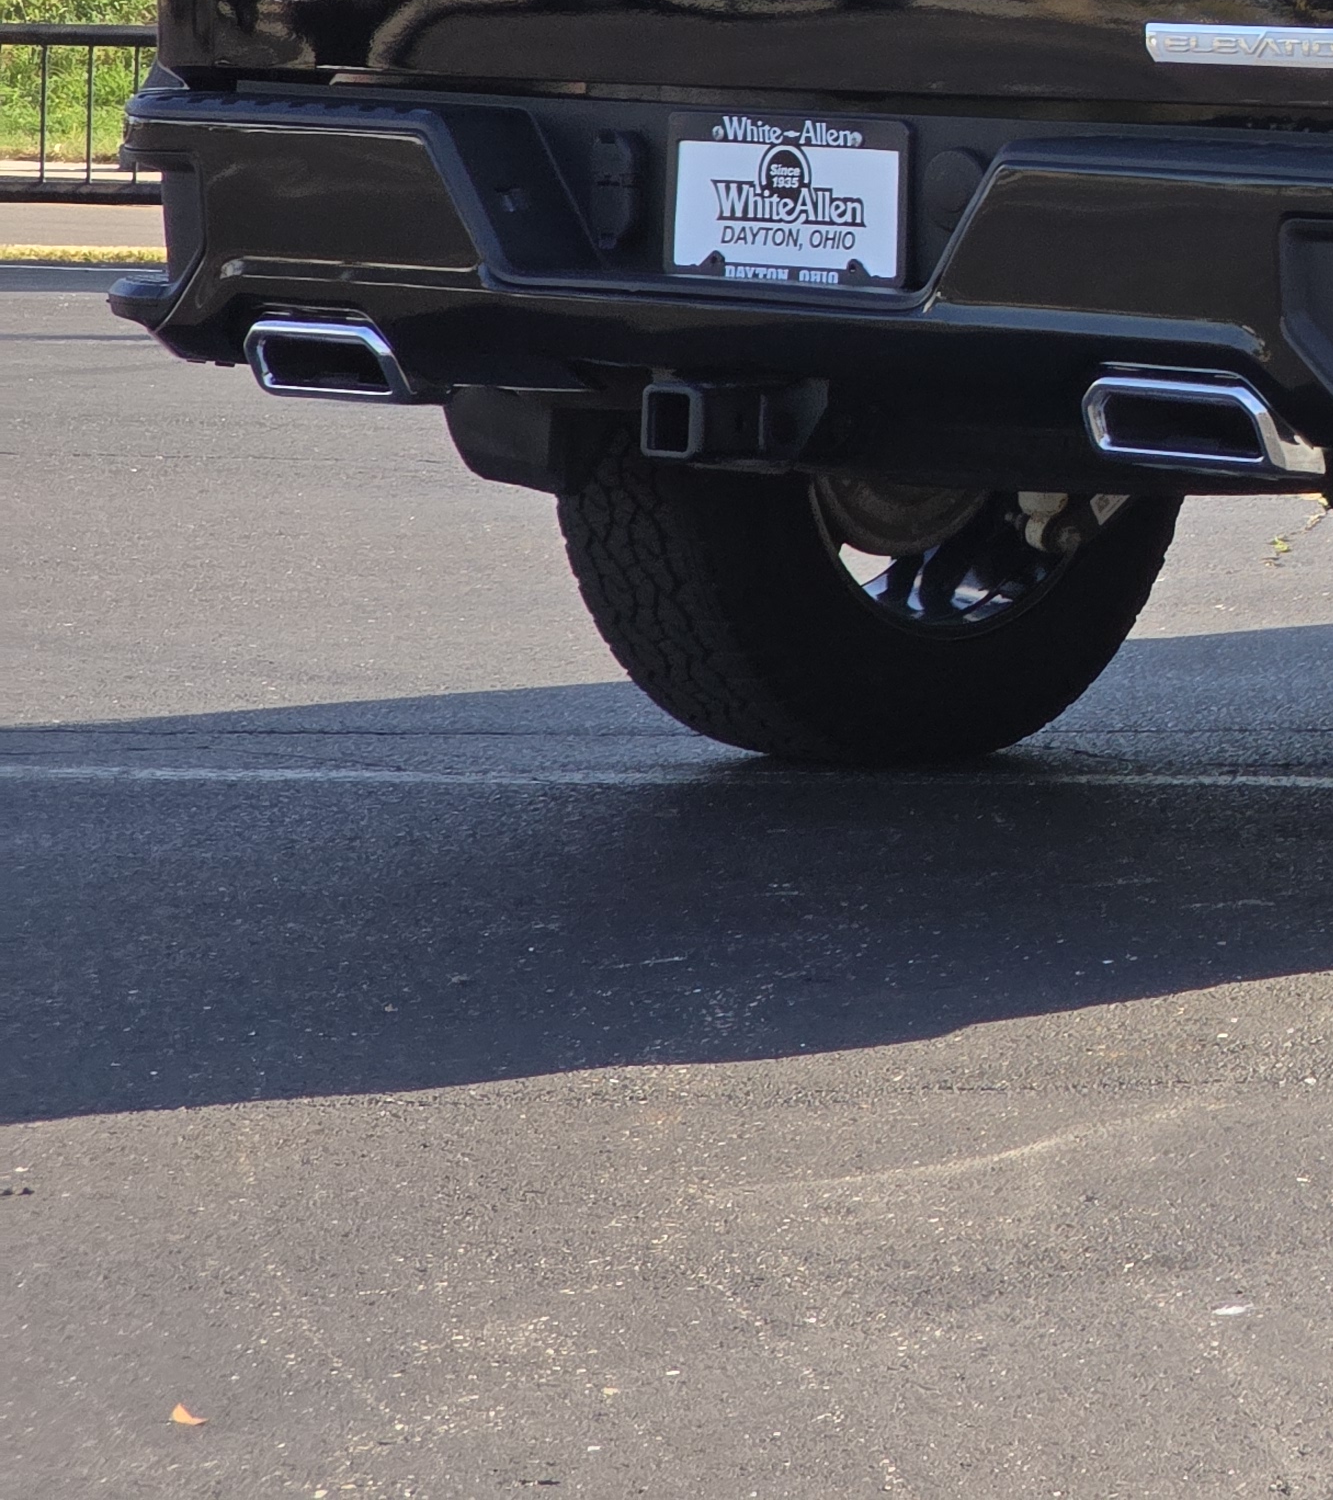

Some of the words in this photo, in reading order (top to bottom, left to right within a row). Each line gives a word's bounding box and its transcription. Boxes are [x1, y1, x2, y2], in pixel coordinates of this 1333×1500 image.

[769, 163, 801, 177] Since
[772, 176, 799, 188] 1935
[720, 225, 804, 251] DAYTON,
[809, 230, 856, 250] OHIO
[725, 264, 789, 281] DAYTON
[798, 269, 839, 284] OHIO
